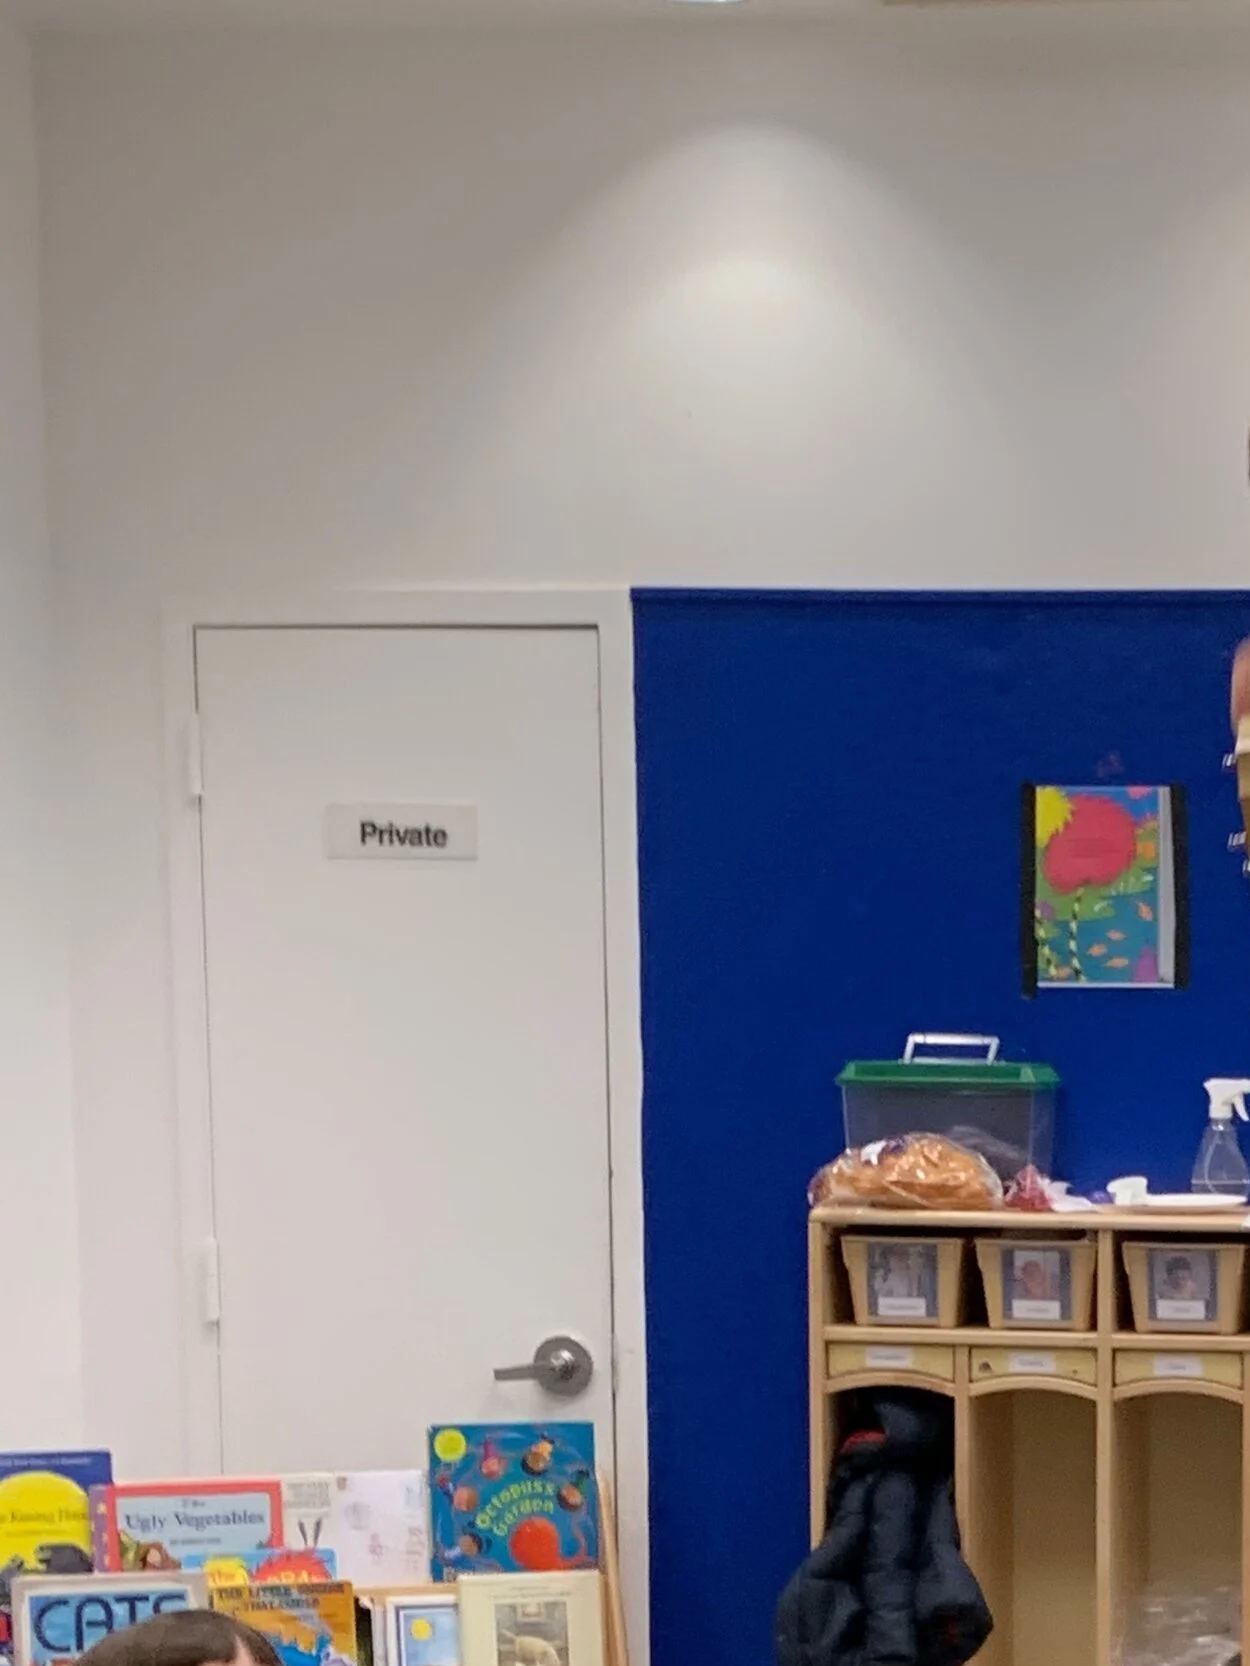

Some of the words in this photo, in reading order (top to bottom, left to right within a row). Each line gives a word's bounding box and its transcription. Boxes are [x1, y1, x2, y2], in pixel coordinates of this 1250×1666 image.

[358, 819, 449, 848] Private
[124, 1513, 168, 1533] Ugly
[173, 1508, 265, 1531] Vegetables
